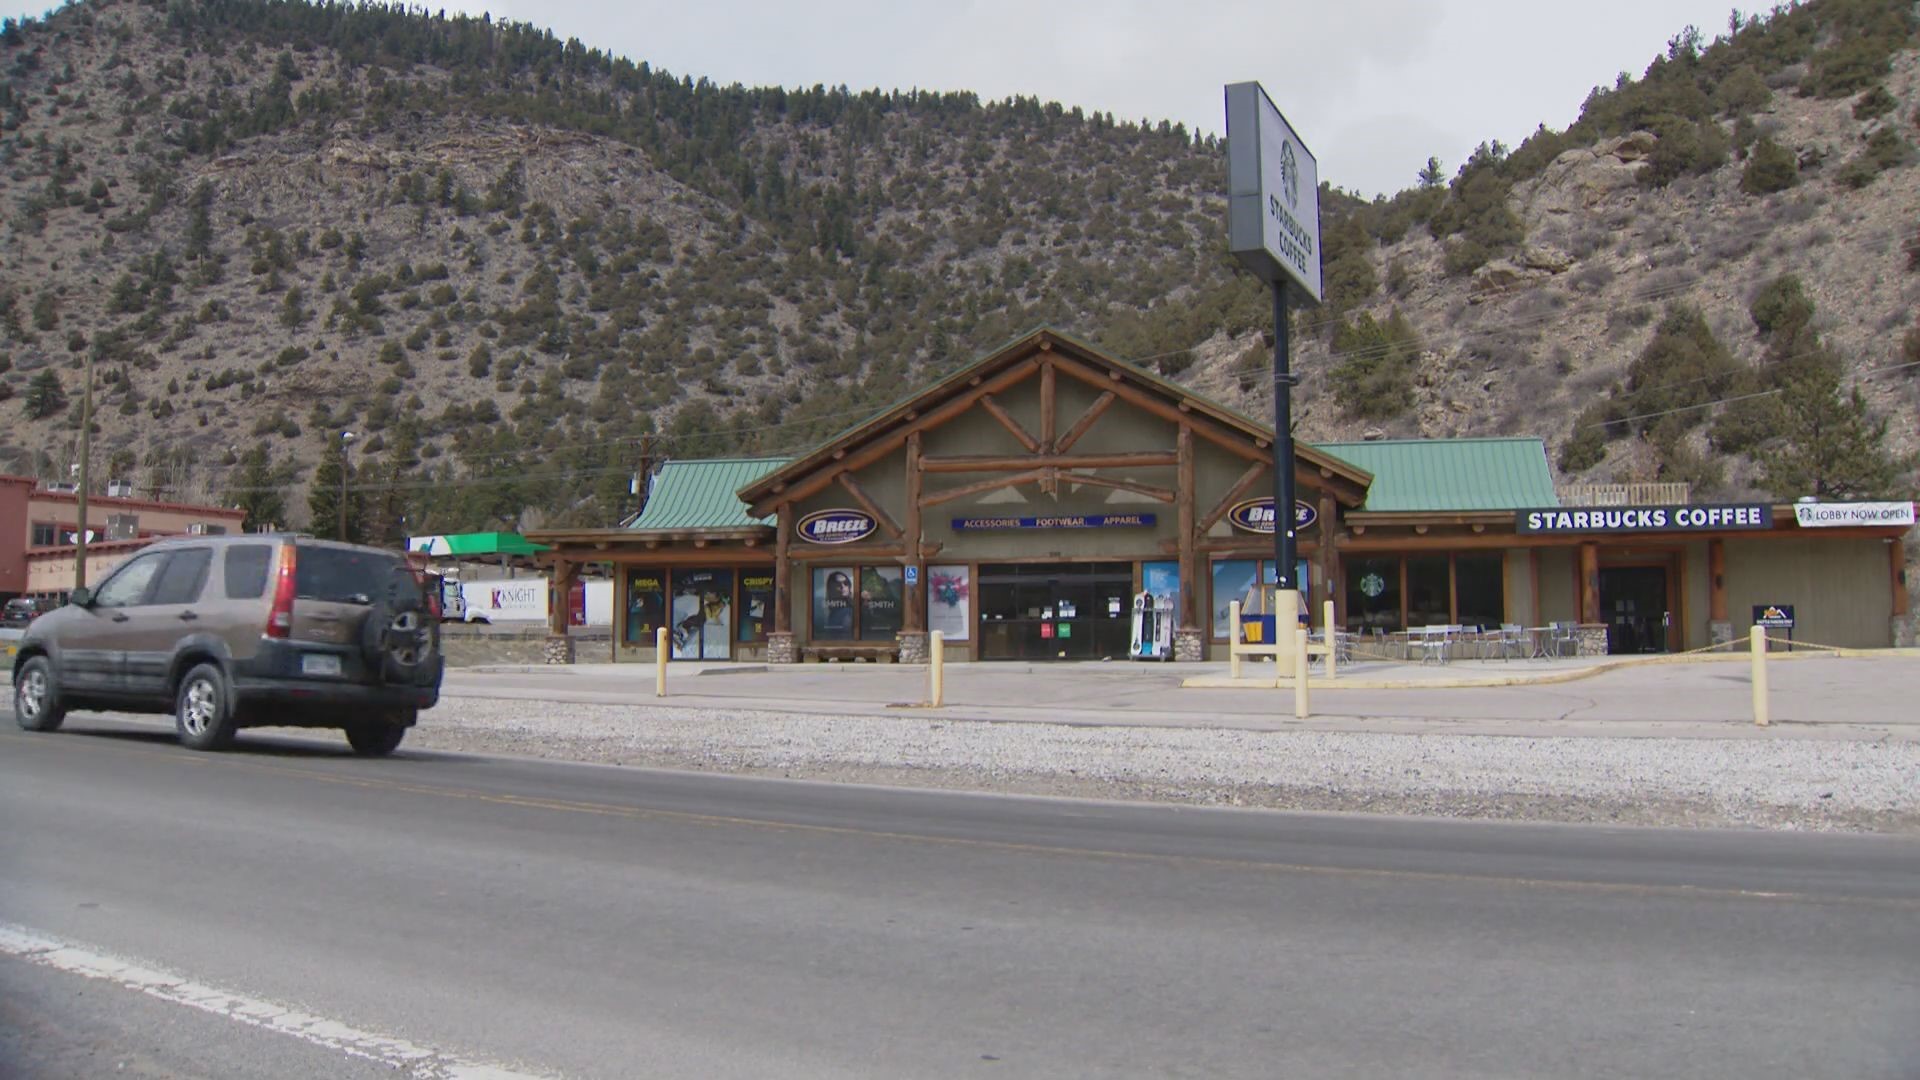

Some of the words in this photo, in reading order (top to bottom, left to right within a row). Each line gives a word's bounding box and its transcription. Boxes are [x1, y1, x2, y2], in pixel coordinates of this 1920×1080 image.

[1270, 194, 1312, 256] STARBUCKS
[1279, 230, 1307, 274] COFFEE
[1528, 510, 1667, 529] STARBUCKS
[1675, 508, 1761, 527] COFFEE
[1816, 510, 1848, 520] LOBBY
[1851, 509, 1877, 519] NOW
[1881, 508, 1909, 519] OPEN
[813, 519, 869, 534] BREEZE
[963, 519, 1021, 528] ACCESSORIES
[1036, 517, 1085, 526] FOOTWEAR
[1103, 516, 1142, 525] APPAREL
[634, 578, 659, 588] MEGA
[743, 577, 774, 586] CRISPY
[502, 588, 536, 602] KNIGHT
[868, 600, 894, 609] SMITH
